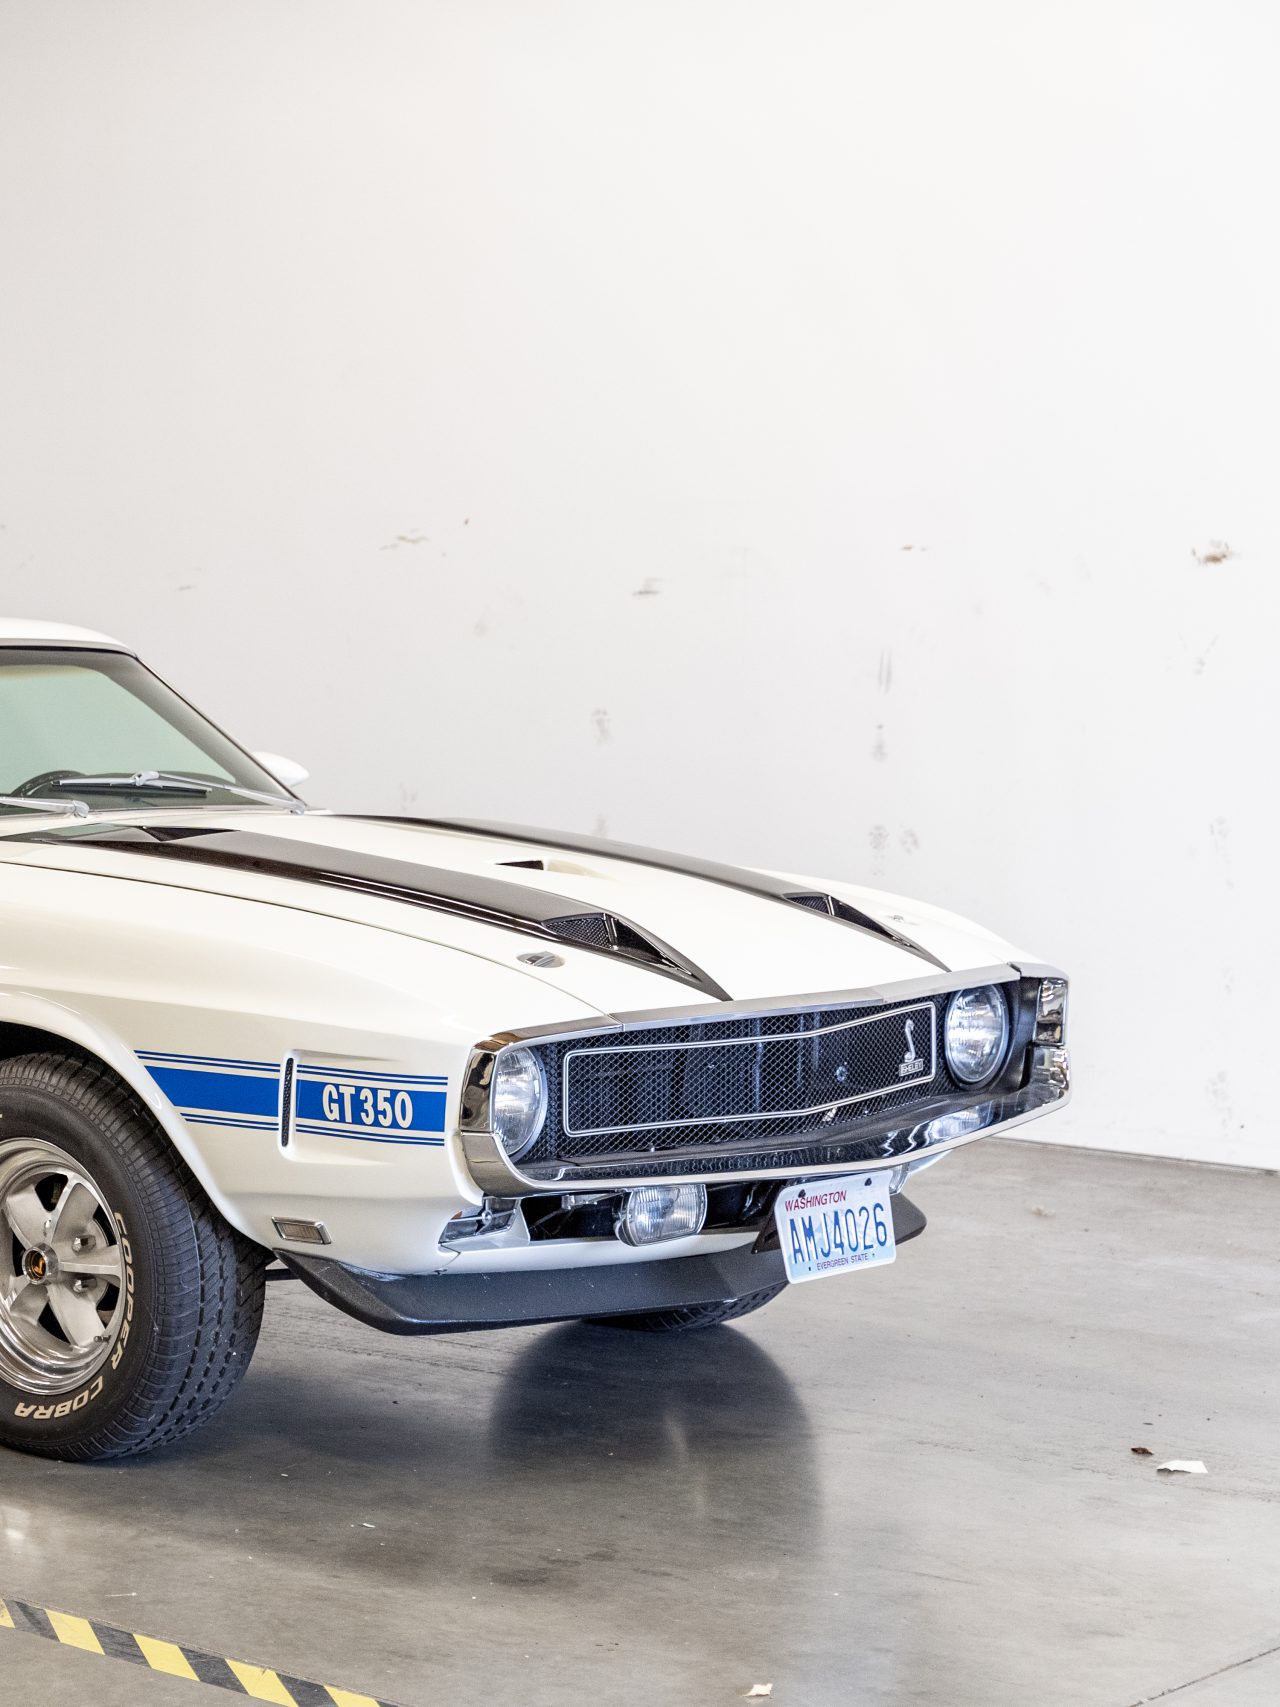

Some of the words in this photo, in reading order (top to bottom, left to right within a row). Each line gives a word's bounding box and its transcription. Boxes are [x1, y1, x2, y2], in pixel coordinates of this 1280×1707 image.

[785, 1190, 847, 1212] WASHINGTON
[789, 1203, 887, 1265] AMJ4026
[816, 1257, 849, 1271] EVERGREEN
[851, 1253, 869, 1265] STATE
[111, 1212, 134, 1370] COOPER
[14, 1375, 103, 1420] COBRA
